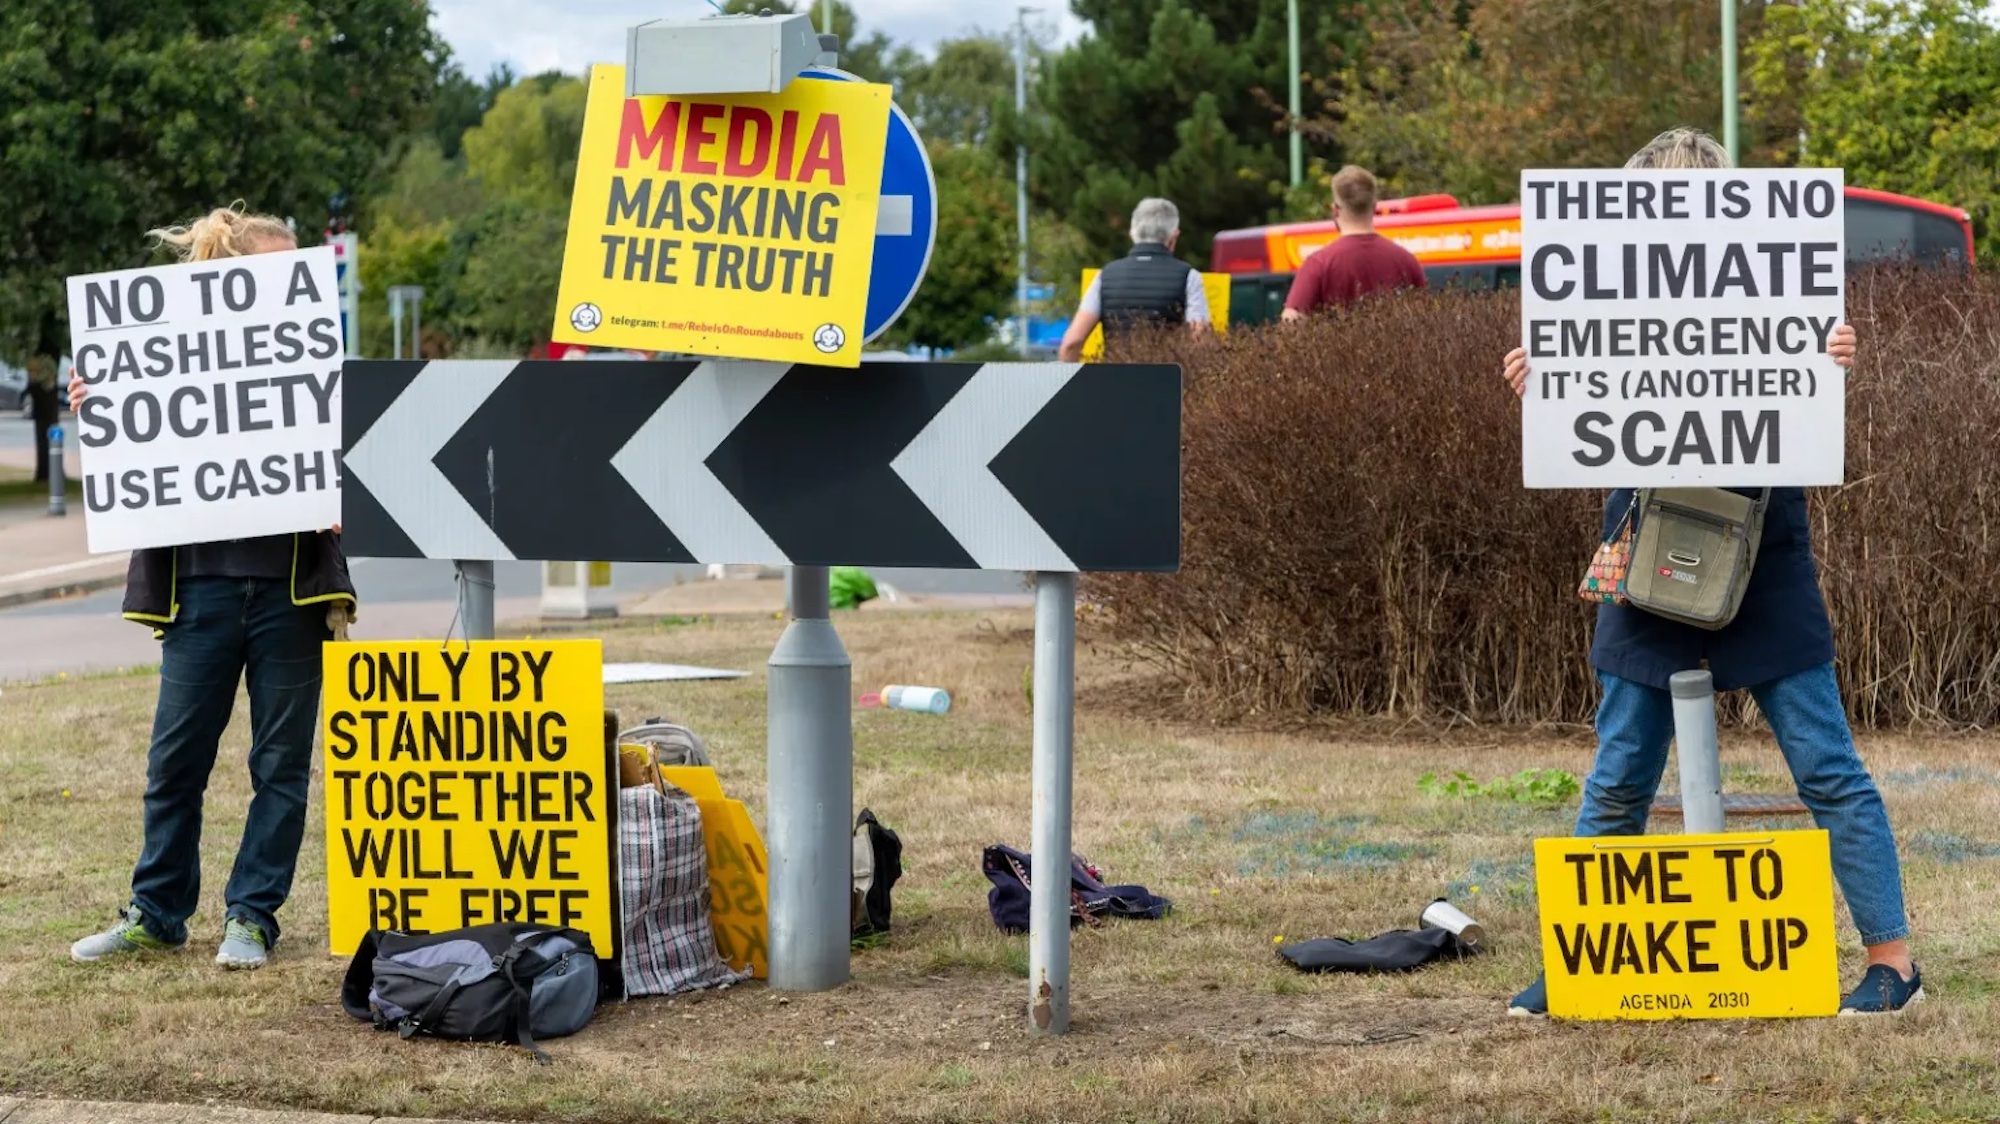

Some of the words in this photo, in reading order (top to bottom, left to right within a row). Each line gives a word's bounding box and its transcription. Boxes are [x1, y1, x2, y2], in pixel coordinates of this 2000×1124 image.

[615, 98, 846, 186] MEDIA
[606, 176, 841, 244] MASKING
[1527, 180, 1690, 220] THERE
[1705, 179, 1752, 220] IS
[1767, 179, 1835, 219] NO
[85, 275, 165, 329] NO
[190, 267, 257, 316] TO
[285, 260, 322, 306] A
[601, 234, 681, 285] THE
[692, 241, 834, 298] TRUTH
[1530, 242, 1839, 302] CLIMATE
[610, 315, 660, 329] telegram:
[1529, 316, 1838, 359] EMERGENCY
[75, 317, 339, 386] CASHLESS
[79, 369, 342, 449] SOCIETY
[1541, 370, 1610, 400] IT'S
[1620, 368, 1817, 400] (ANOTHER)
[1571, 410, 1781, 467] SCAM
[85, 465, 182, 513] USE
[194, 449, 342, 502] CASH!
[348, 651, 470, 703] ONLY
[490, 651, 554, 703] BY
[329, 710, 568, 762] STANDING
[333, 770, 596, 822] TOGETHER
[341, 828, 474, 880] WILL
[488, 828, 580, 881] WE
[1564, 850, 1692, 906] TIME
[1713, 848, 1783, 903] TO
[369, 888, 430, 935] BE
[1553, 920, 1720, 976] WAKE
[1739, 917, 1809, 972] UP
[1619, 993, 1693, 1010] AGENDA
[1708, 991, 1750, 1008] 2030
